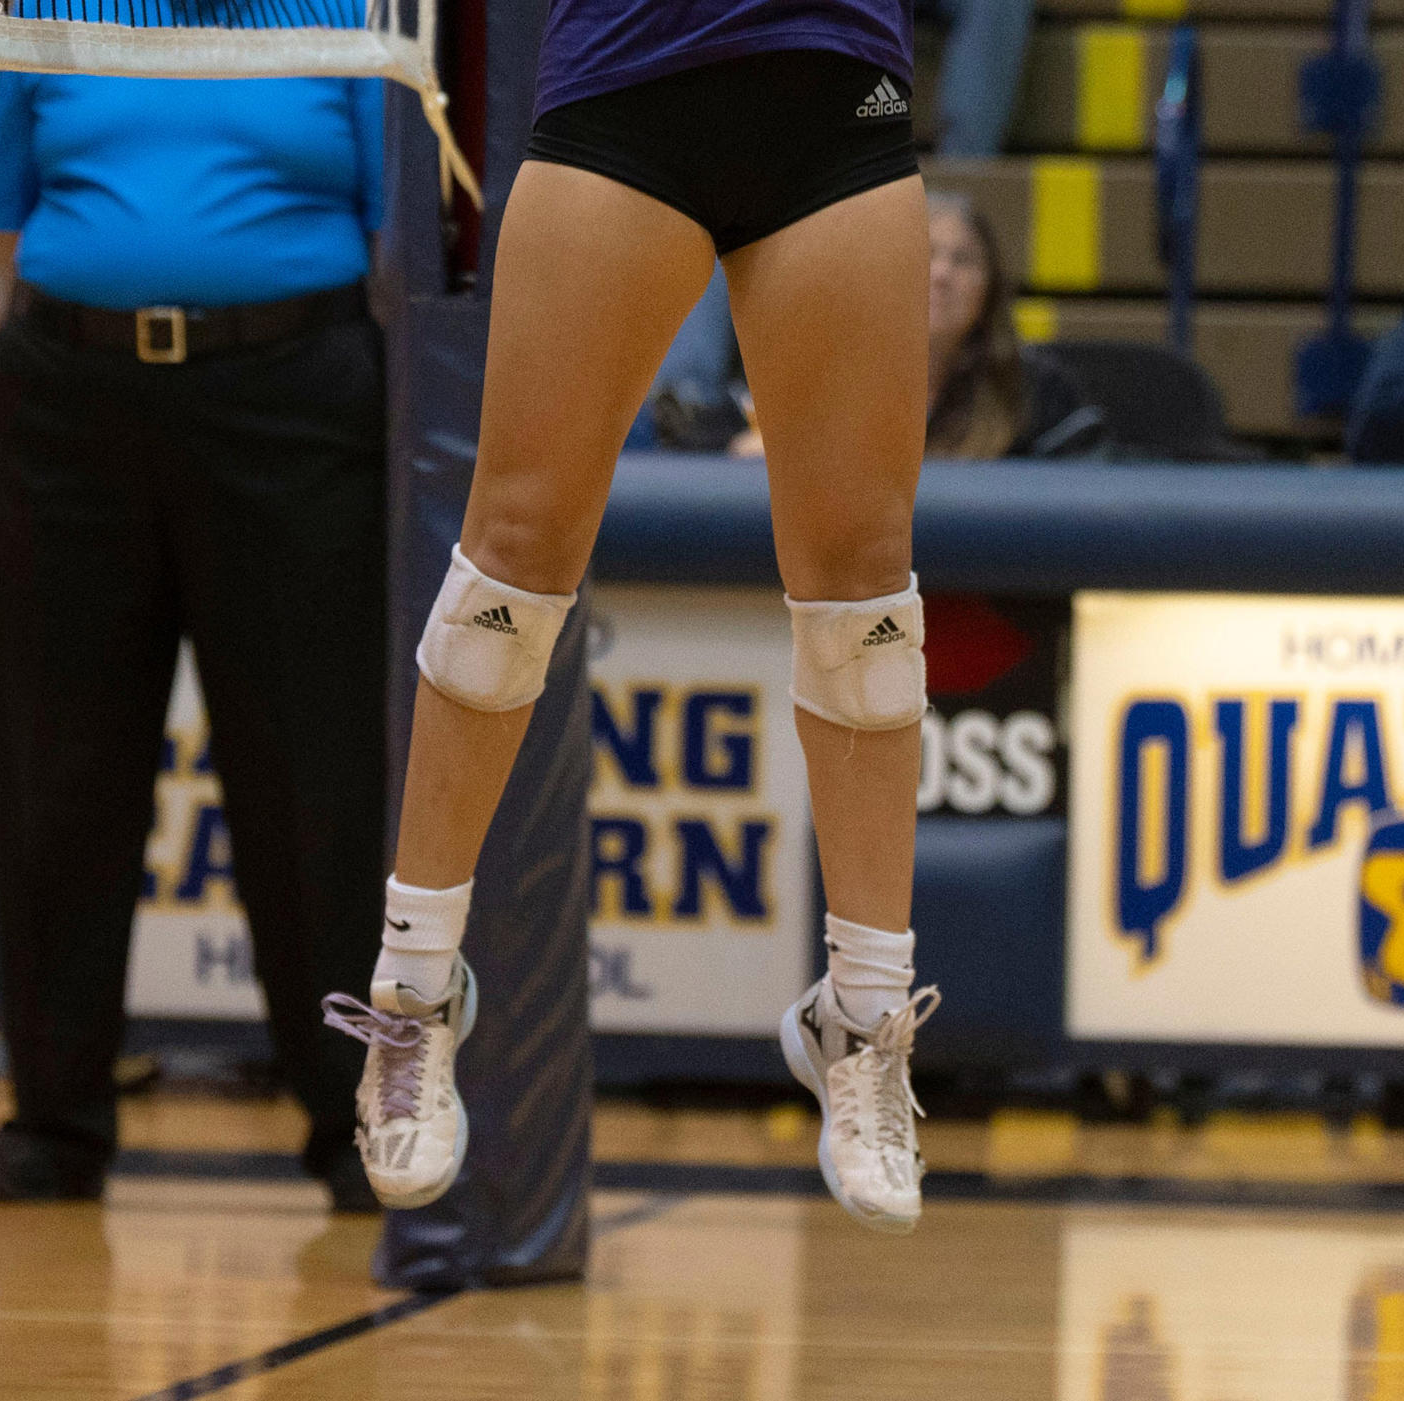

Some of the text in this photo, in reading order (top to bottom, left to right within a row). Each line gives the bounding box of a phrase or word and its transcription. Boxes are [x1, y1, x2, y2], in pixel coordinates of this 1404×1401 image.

[856, 99, 908, 118] adidas
[473, 615, 518, 636] adidas
[861, 630, 907, 647] adidas
